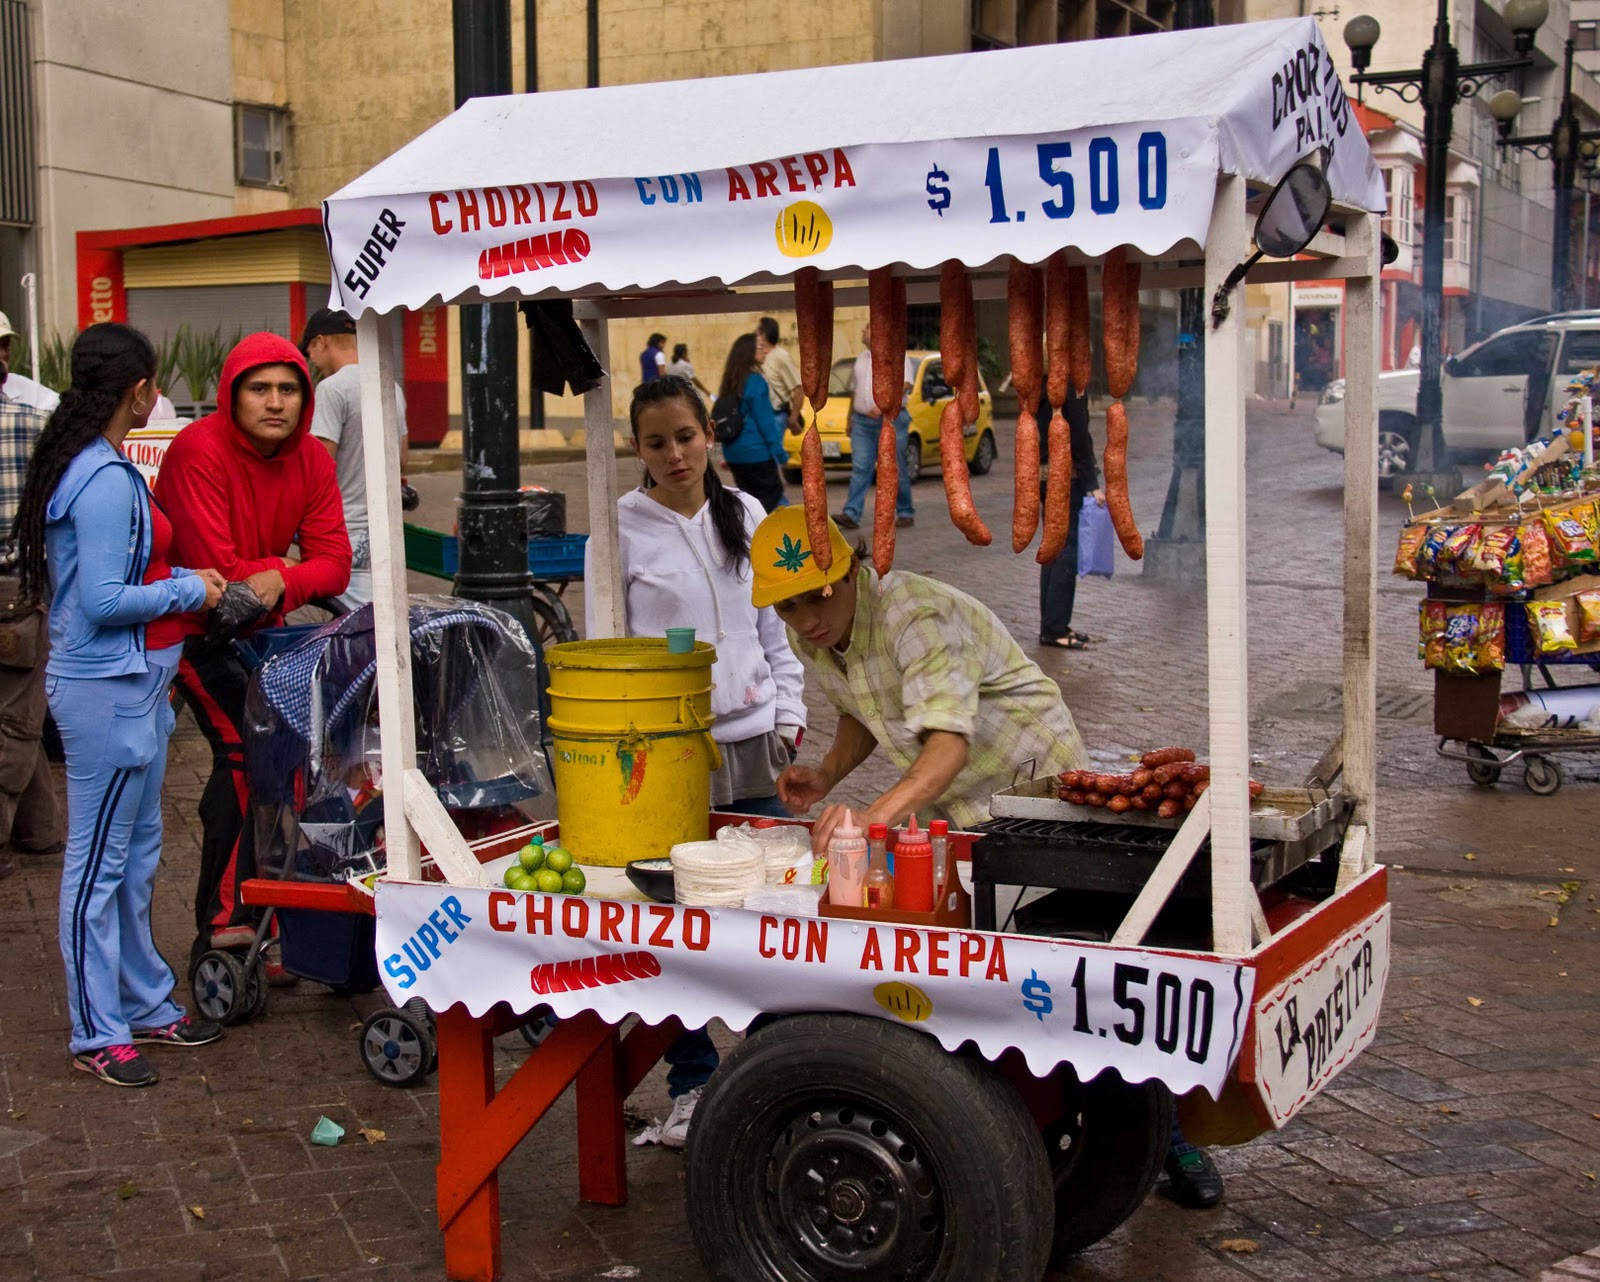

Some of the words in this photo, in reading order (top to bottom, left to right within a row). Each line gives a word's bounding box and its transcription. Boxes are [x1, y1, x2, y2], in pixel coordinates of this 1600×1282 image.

[1271, 42, 1350, 138] CHORZOS
[429, 180, 599, 236] CHORIZO
[634, 171, 704, 207] CON
[727, 147, 857, 202] AREPA
[926, 162, 952, 217] $
[984, 130, 1168, 224] 1.500
[344, 208, 406, 299] SUPER
[383, 894, 473, 990] SUPER
[488, 891, 711, 952] CHORIZO
[759, 915, 829, 964] CON
[859, 926, 1010, 983] AREPA
[1021, 968, 1054, 1023] $
[1070, 956, 1215, 1065] 1.500
[1274, 995, 1303, 1077] LA
